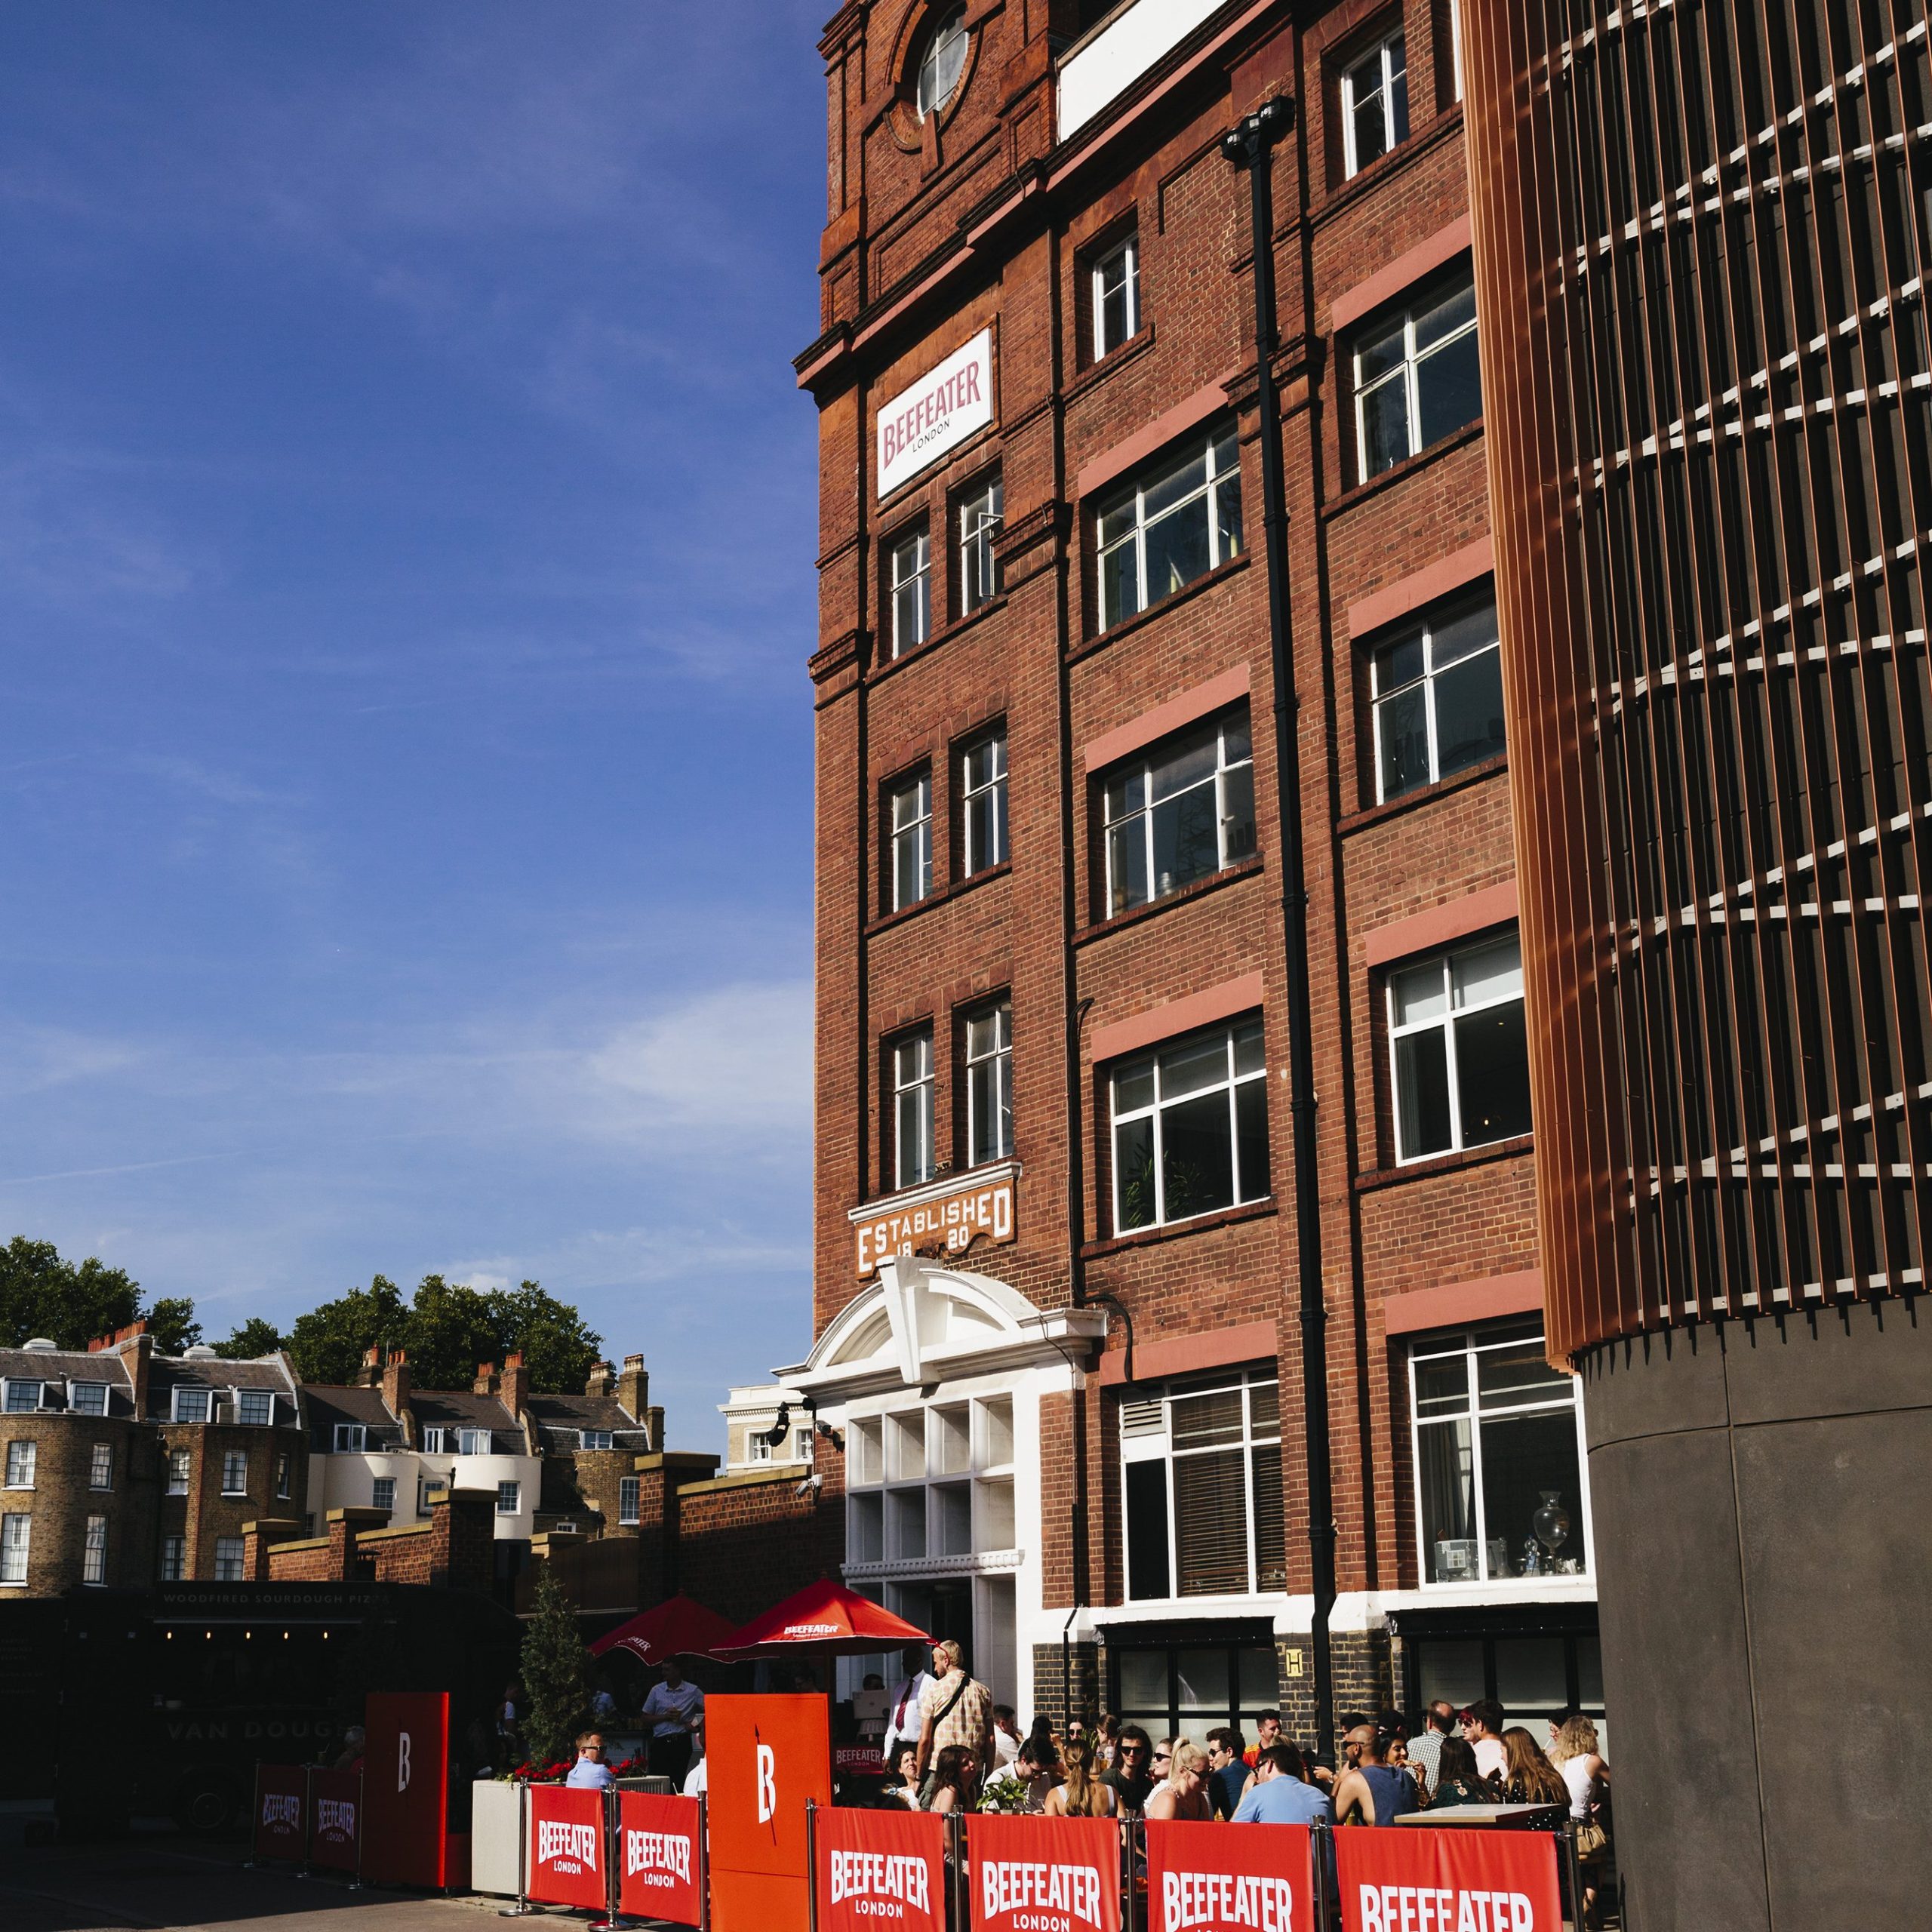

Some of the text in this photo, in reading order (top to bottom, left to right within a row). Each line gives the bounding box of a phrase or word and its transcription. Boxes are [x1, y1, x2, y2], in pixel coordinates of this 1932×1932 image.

[883, 361, 982, 471] BEEFEATER
[912, 418, 950, 453] LONDON
[858, 1187, 1011, 1273] ESTABLISHED
[897, 1225, 969, 1257] 18 20
[163, 1594, 249, 1603] WOODFIRED
[255, 1594, 342, 1604] SOURDOUGH
[784, 1624, 838, 1635] BEEFEATER
[1288, 1653, 1300, 1674] H
[166, 1722, 227, 1739] VAN
[398, 1732, 411, 1793] B
[836, 1749, 881, 1764] BEEFEATER
[757, 1744, 777, 1824] B
[318, 1798, 355, 1840] BEEFEATER
[538, 1820, 597, 1872] BEEFEATER
[627, 1829, 691, 1886] BEEFEATER
[553, 1860, 582, 1875] LONDON
[644, 1872, 675, 1888] LONDON
[831, 1850, 931, 1915] BEEFEATER
[855, 1899, 903, 1919] LONDON
[983, 1861, 1102, 1930] BEEFEATER
[1163, 1871, 1293, 1932] BEEFEATER
[1013, 1913, 1070, 1932] LONDON
